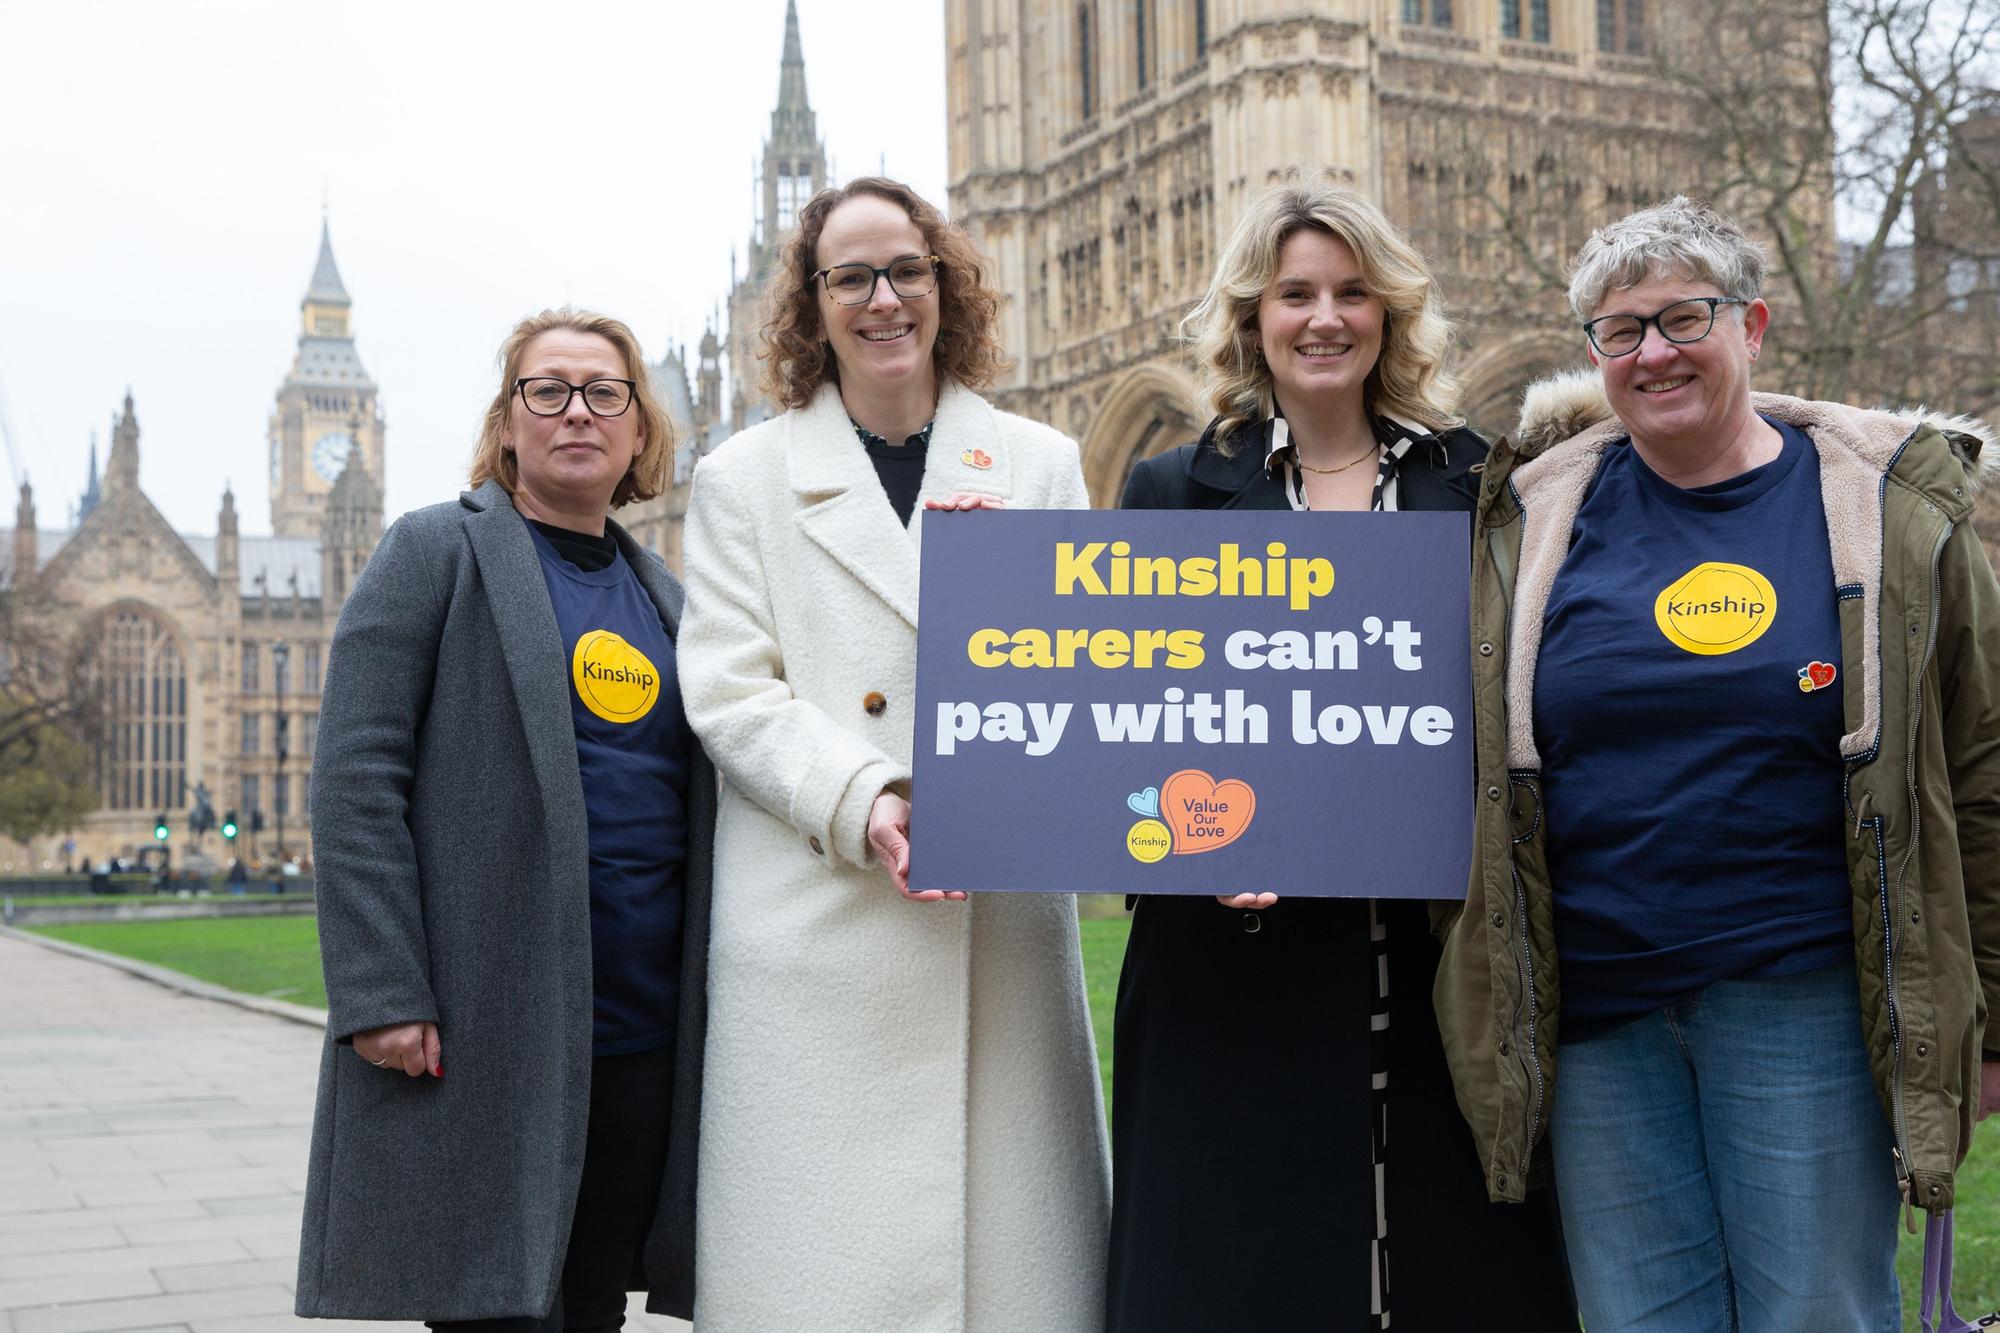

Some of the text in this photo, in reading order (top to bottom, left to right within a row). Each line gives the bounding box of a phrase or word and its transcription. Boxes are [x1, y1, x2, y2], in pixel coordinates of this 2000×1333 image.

[1055, 541, 1335, 611] Kinship
[1667, 595, 1766, 619] Kinship
[967, 616, 1423, 671] carers can’t
[583, 660, 654, 691] Kinship
[935, 687, 1454, 757] pay with love
[1183, 798, 1229, 813] Value
[1186, 823, 1225, 837] Love
[1194, 813, 1218, 824] Our
[1131, 836, 1168, 848] Kinship
